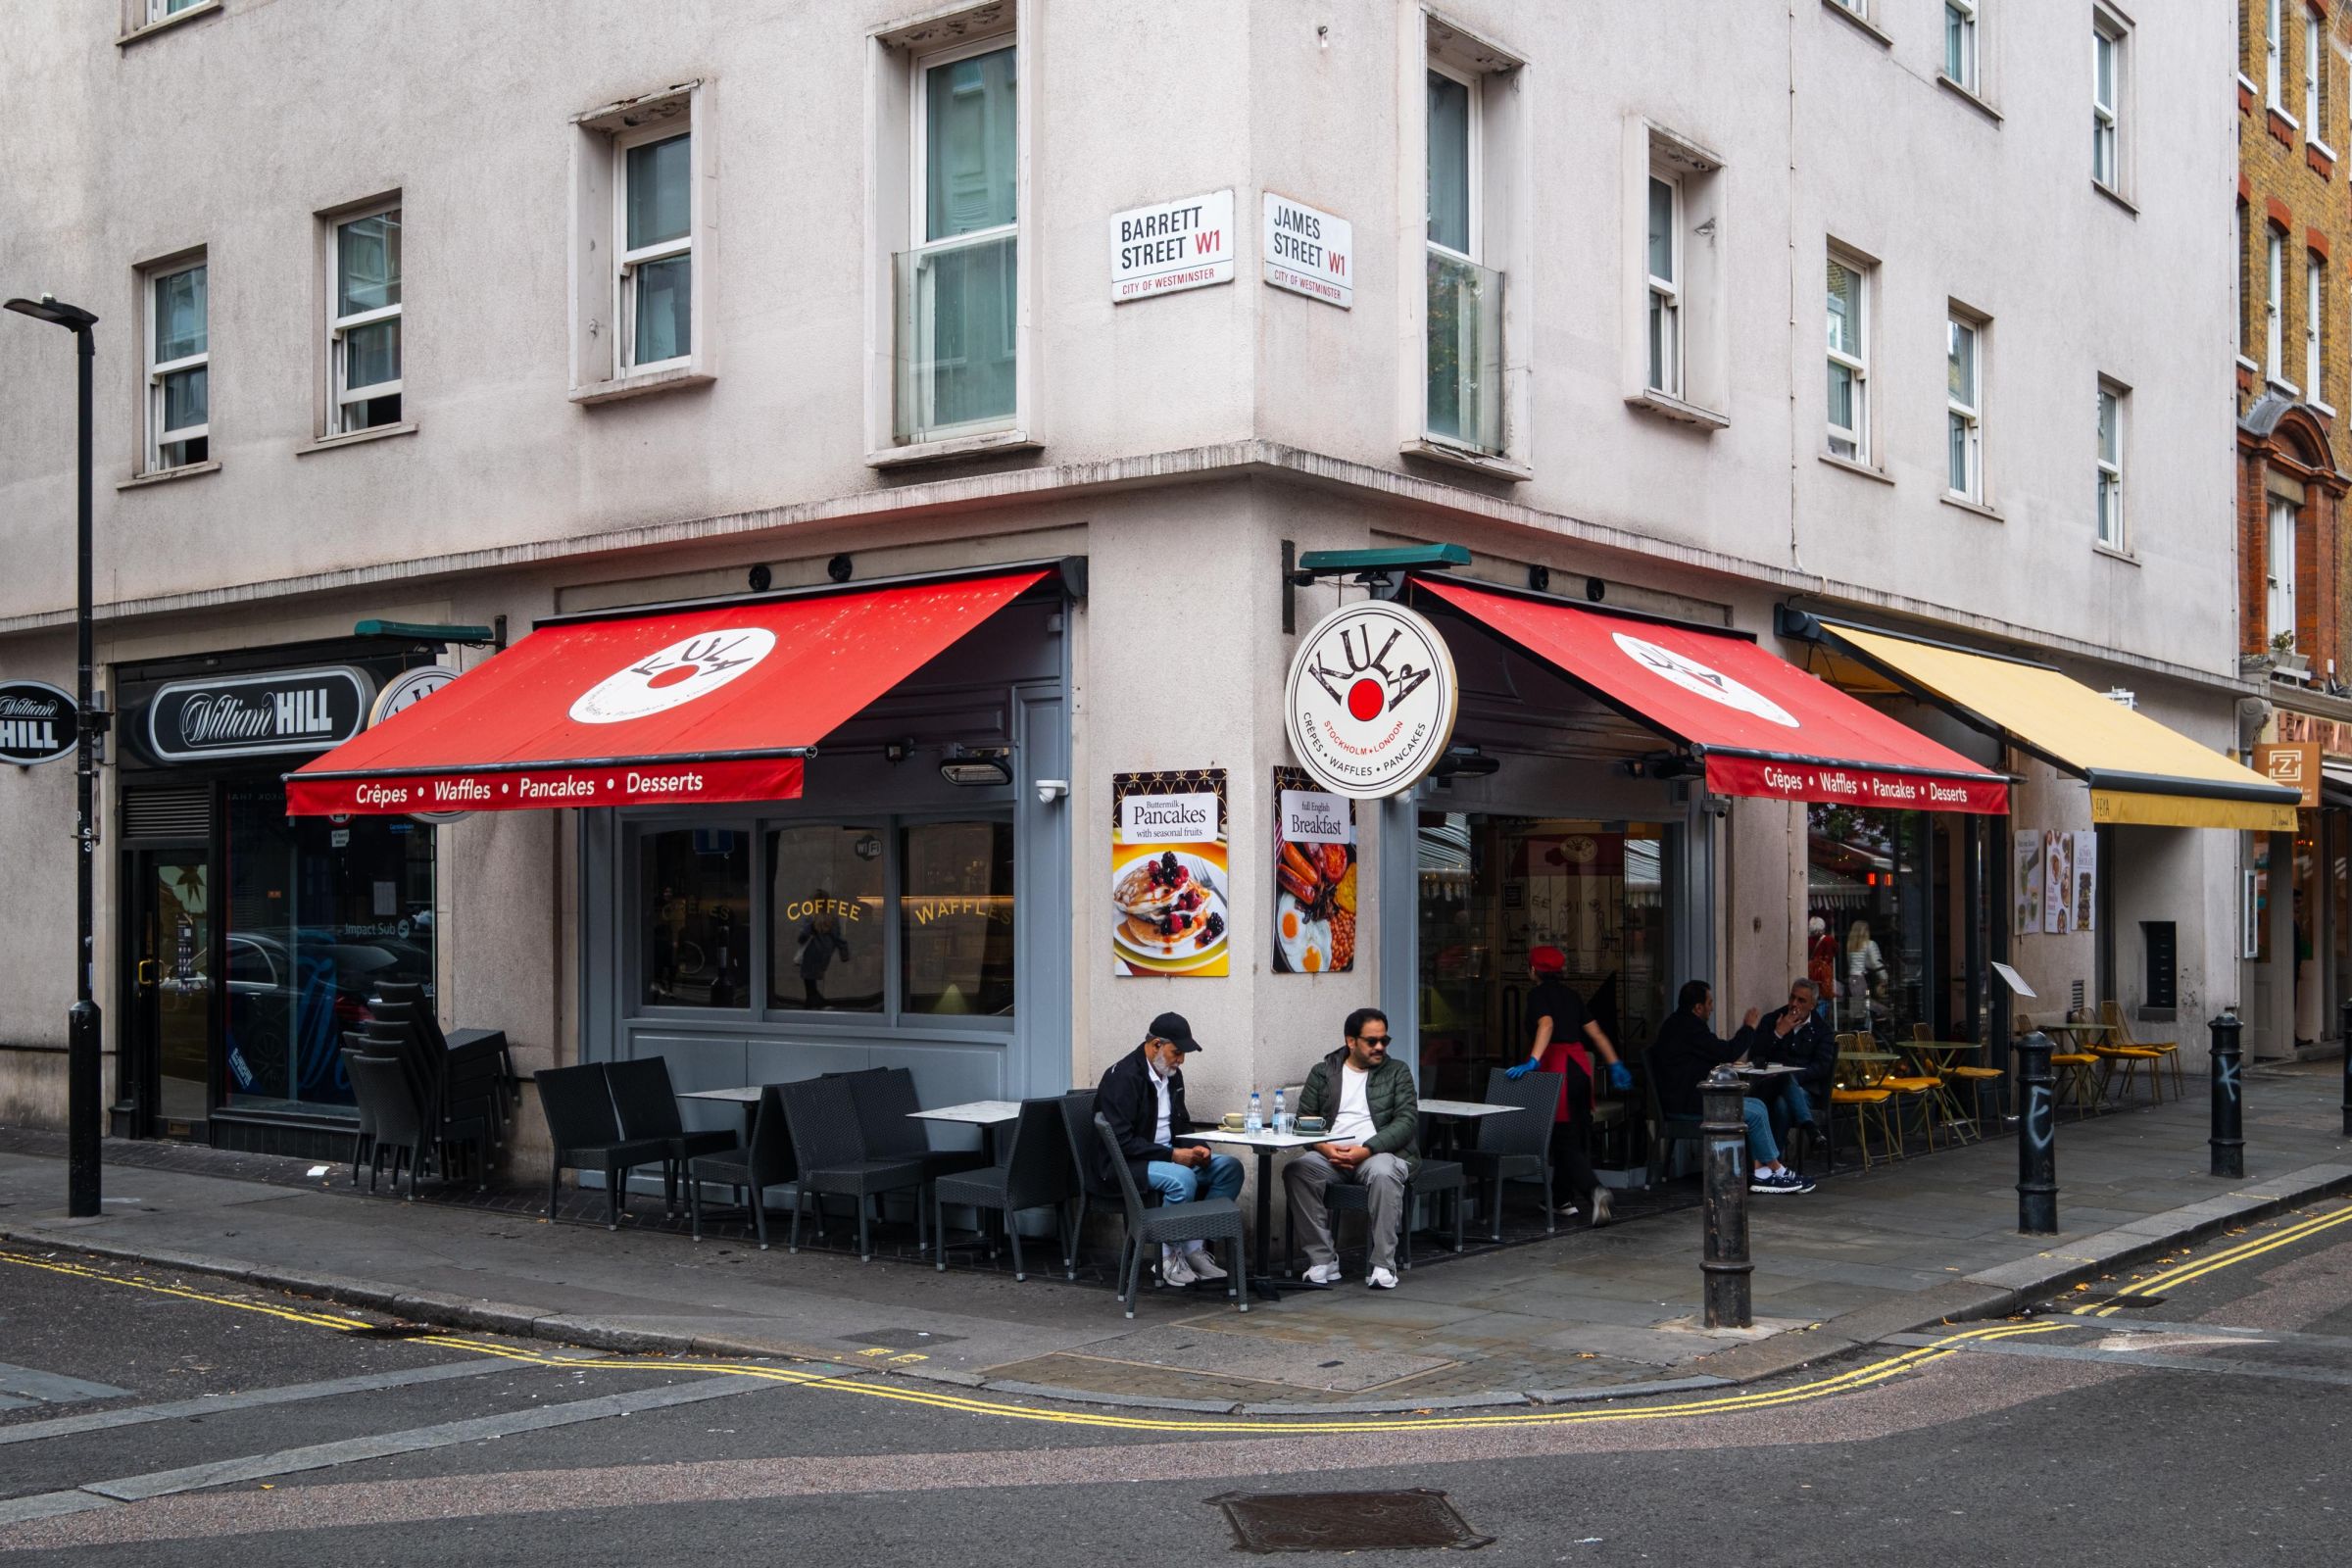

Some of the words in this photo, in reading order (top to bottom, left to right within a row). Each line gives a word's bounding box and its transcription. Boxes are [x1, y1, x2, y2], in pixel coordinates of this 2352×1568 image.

[1121, 206, 1203, 243] BARRETT
[1274, 205, 1321, 239] JAMES
[1121, 236, 1187, 270] STREET
[1195, 229, 1221, 255] W1
[1274, 231, 1323, 269] STREET
[1328, 250, 1346, 276] W1
[1122, 282, 1139, 295] CITY
[1143, 280, 1152, 291] OF
[1154, 269, 1214, 288] WESTMINSTER
[1274, 270, 1289, 283] CITY
[1290, 274, 1298, 285] OF
[1299, 277, 1342, 299] WESTMINSTER
[631, 635, 754, 677] KULA
[1308, 623, 1431, 712] KULA
[179, 692, 276, 745] William
[276, 689, 332, 735] HILL
[0, 720, 59, 749] HILL
[1303, 711, 1324, 753] CRÊPES
[1329, 756, 1373, 776] WAFFLES
[1383, 722, 1426, 771] PANCAKES
[1324, 720, 1367, 756] STOCKHOLM
[1373, 720, 1403, 753] LONDON
[2278, 759, 2292, 773] Z
[356, 783, 408, 808] Crêpes
[434, 779, 491, 801] Waffles
[519, 776, 595, 798] Pancakes
[626, 772, 704, 794] Desserts
[1764, 766, 1803, 794] Crêpes
[1820, 772, 1857, 795] Waffles
[1873, 777, 1916, 799] Pancakes
[1930, 782, 1968, 803] Desserts
[1134, 804, 1206, 825] Pancakes
[1147, 800, 1180, 809] Buttermilk
[1301, 801, 1310, 811] full
[1311, 803, 1330, 814] English
[1137, 829, 1152, 838] with
[1153, 828, 1183, 838] seasonal
[1184, 827, 1202, 837] fruits
[1292, 814, 1342, 835] Breakfast
[786, 899, 861, 922] COFFEE
[914, 898, 1013, 926] WAFFLES
